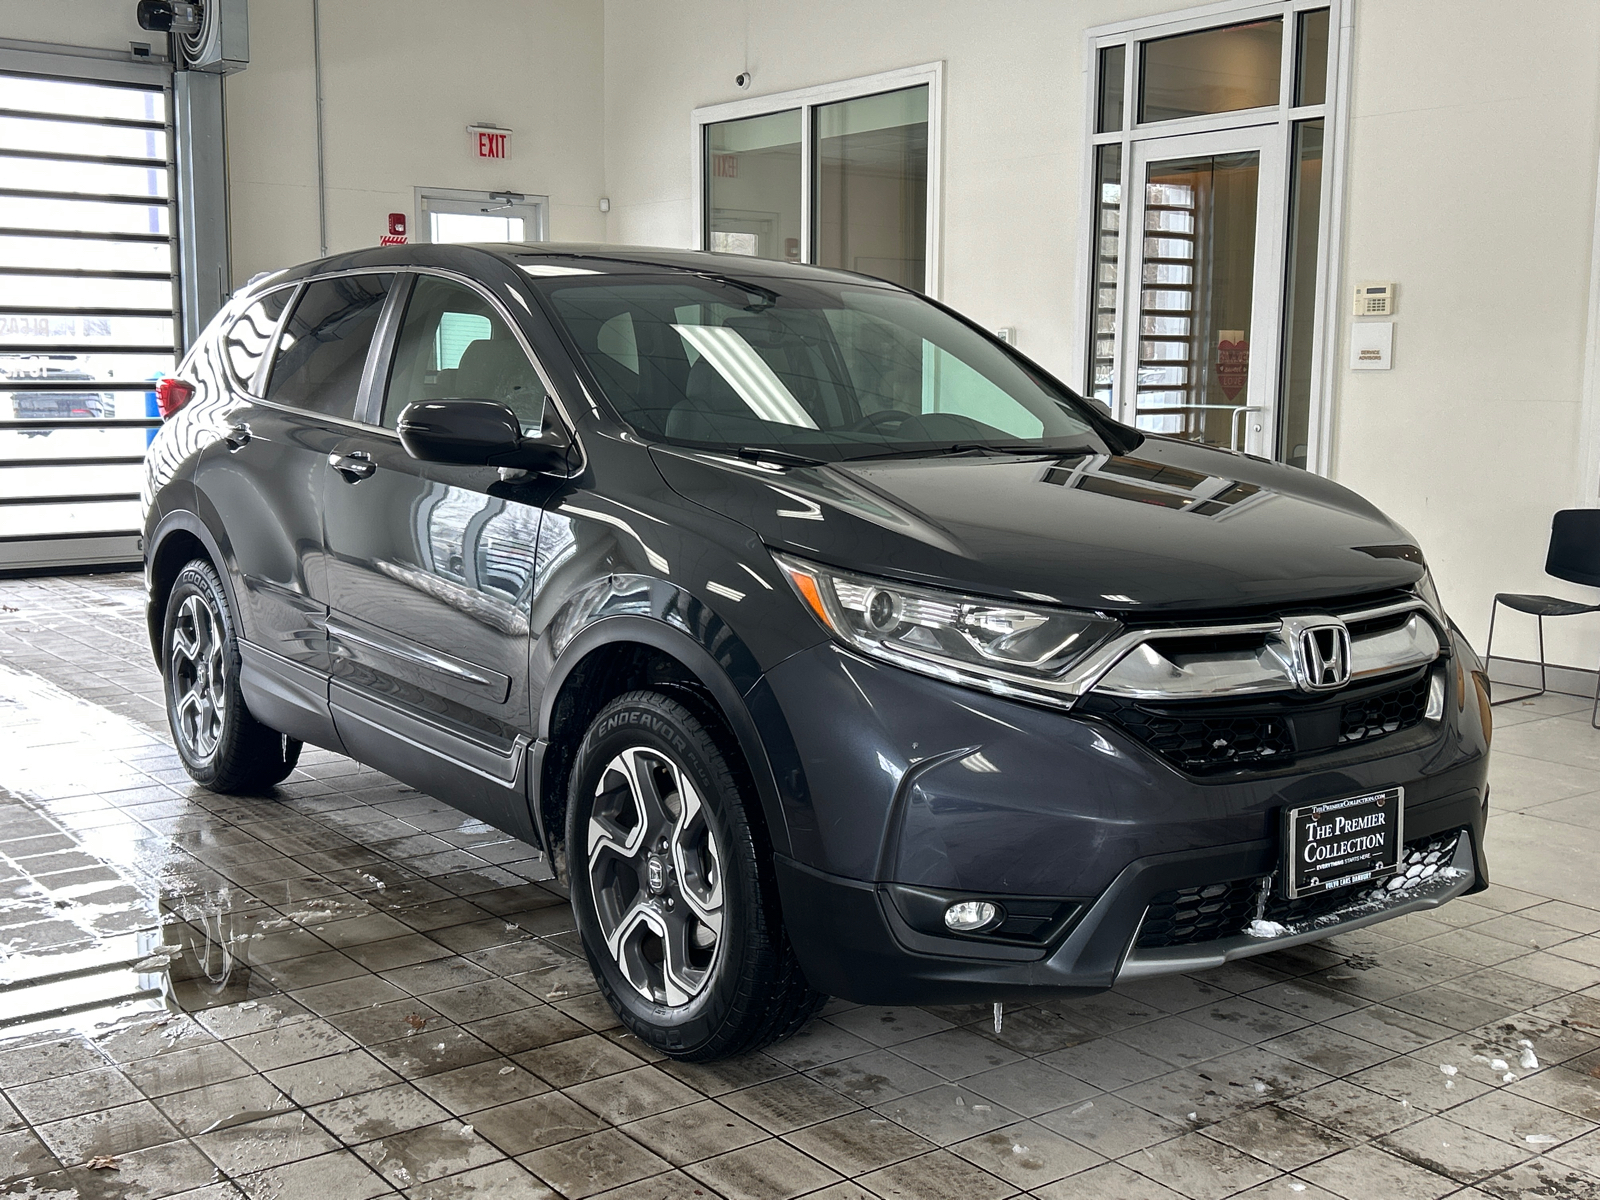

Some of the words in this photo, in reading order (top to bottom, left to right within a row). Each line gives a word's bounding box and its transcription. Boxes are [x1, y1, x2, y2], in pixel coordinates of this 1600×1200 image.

[479, 133, 507, 158] EXIT
[182, 571, 219, 615] COOPER
[599, 711, 687, 753] ENDEAVOR
[688, 752, 710, 787] PLUS
[1305, 822, 1333, 841] THE
[1334, 812, 1386, 835] PREMIER
[1304, 832, 1385, 863] COLLECTION
[1316, 859, 1344, 870] EVERYTHING
[1344, 856, 1360, 864] STARTS
